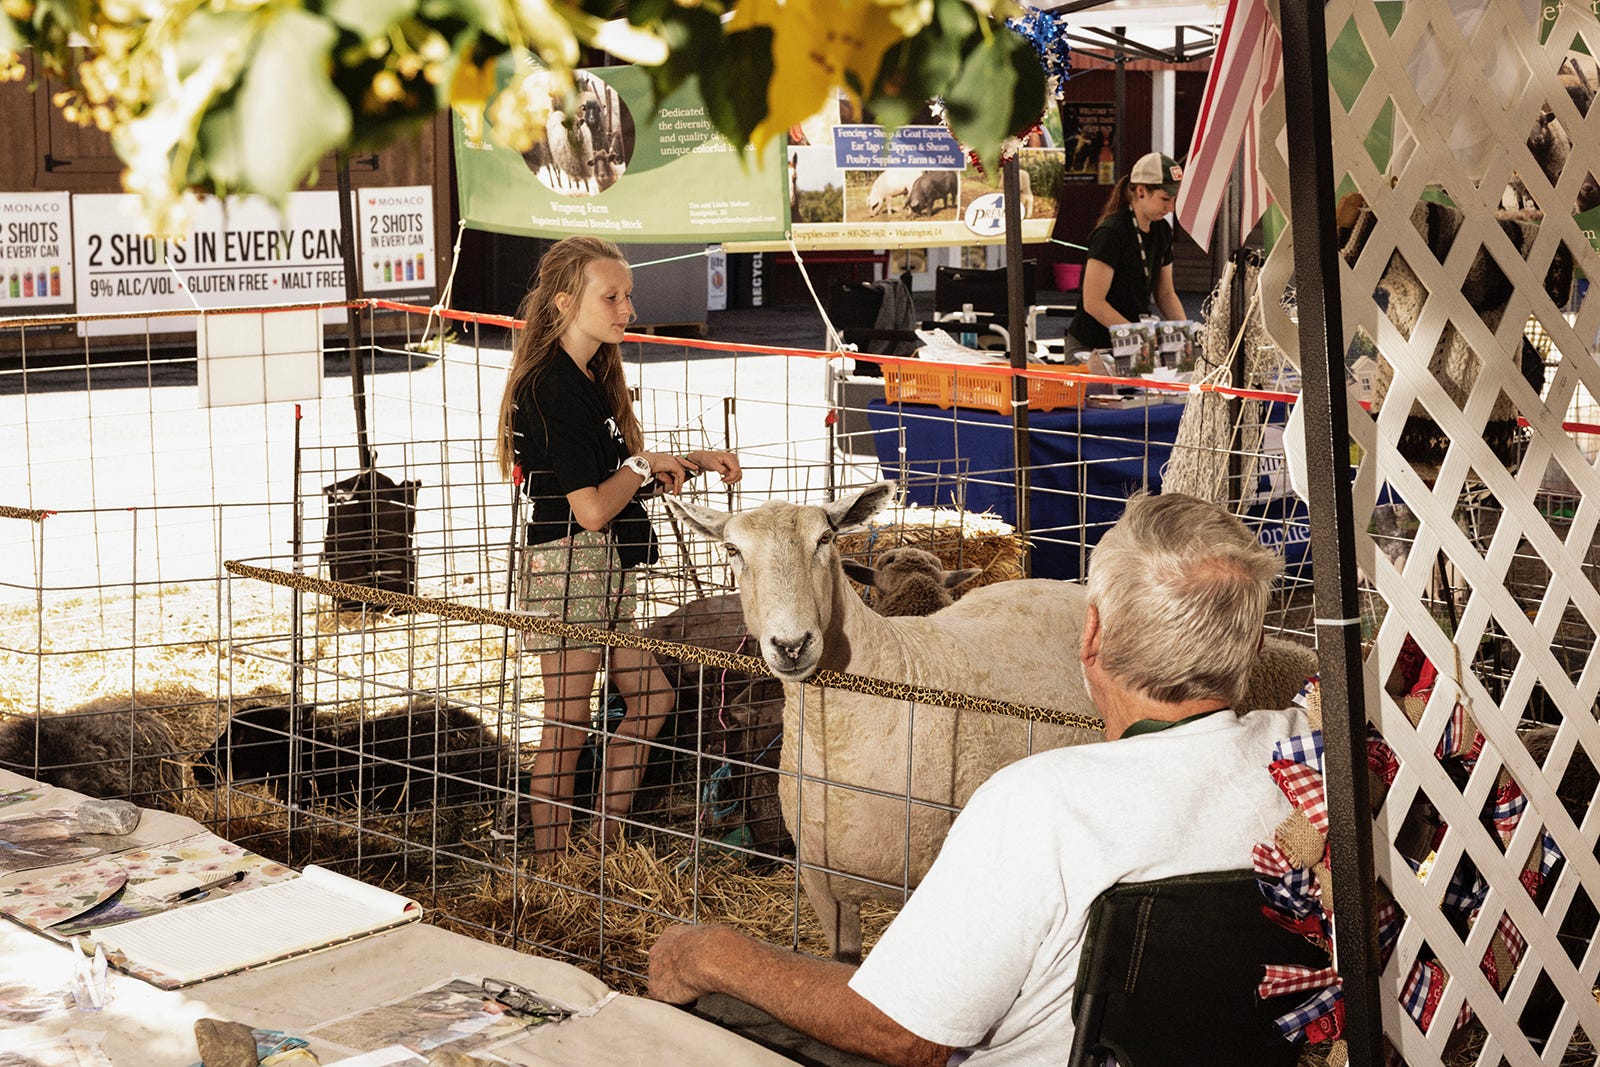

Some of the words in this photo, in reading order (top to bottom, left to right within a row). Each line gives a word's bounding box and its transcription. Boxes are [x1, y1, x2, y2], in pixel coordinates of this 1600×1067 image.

[658, 122, 672, 131] the
[659, 133, 675, 143] and
[678, 131, 708, 144] quality
[837, 128, 867, 140] Fencing
[903, 128, 921, 138] Goat
[660, 145, 690, 157] unique
[692, 143, 726, 154] colorful
[851, 142, 866, 151] Ear
[866, 141, 880, 153] Tags
[886, 141, 916, 156] Clippers
[918, 143, 924, 151] &
[925, 142, 950, 151] Shears
[845, 154, 871, 166] Poultry
[872, 155, 901, 167] Supplies
[907, 155, 927, 164] Farm
[928, 156, 936, 164] to
[937, 155, 955, 165] Table
[378, 195, 425, 206] MONACO
[586, 202, 609, 213] Farm
[3, 203, 60, 213] MONACO
[369, 215, 378, 234] 2
[382, 213, 423, 234] SHOTS
[620, 219, 644, 229] Stock
[8, 221, 59, 243] SHOTS
[88, 234, 103, 267] 2
[110, 232, 187, 266] SHOTS
[194, 231, 217, 263] IN
[224, 229, 295, 262] EVERY
[302, 228, 344, 260] CAN
[371, 236, 379, 248] IN
[381, 234, 406, 247] EVERY
[408, 233, 425, 246] CAN
[7, 245, 37, 259] EVERY
[40, 244, 59, 258] CAN
[90, 279, 113, 298] 9%
[117, 277, 175, 297] ALC/VOL
[188, 274, 235, 293] GLUTEN
[239, 273, 269, 291] FREE
[281, 270, 313, 289] MALT
[316, 270, 345, 288] FREE
[752, 252, 763, 306] RECYCL
